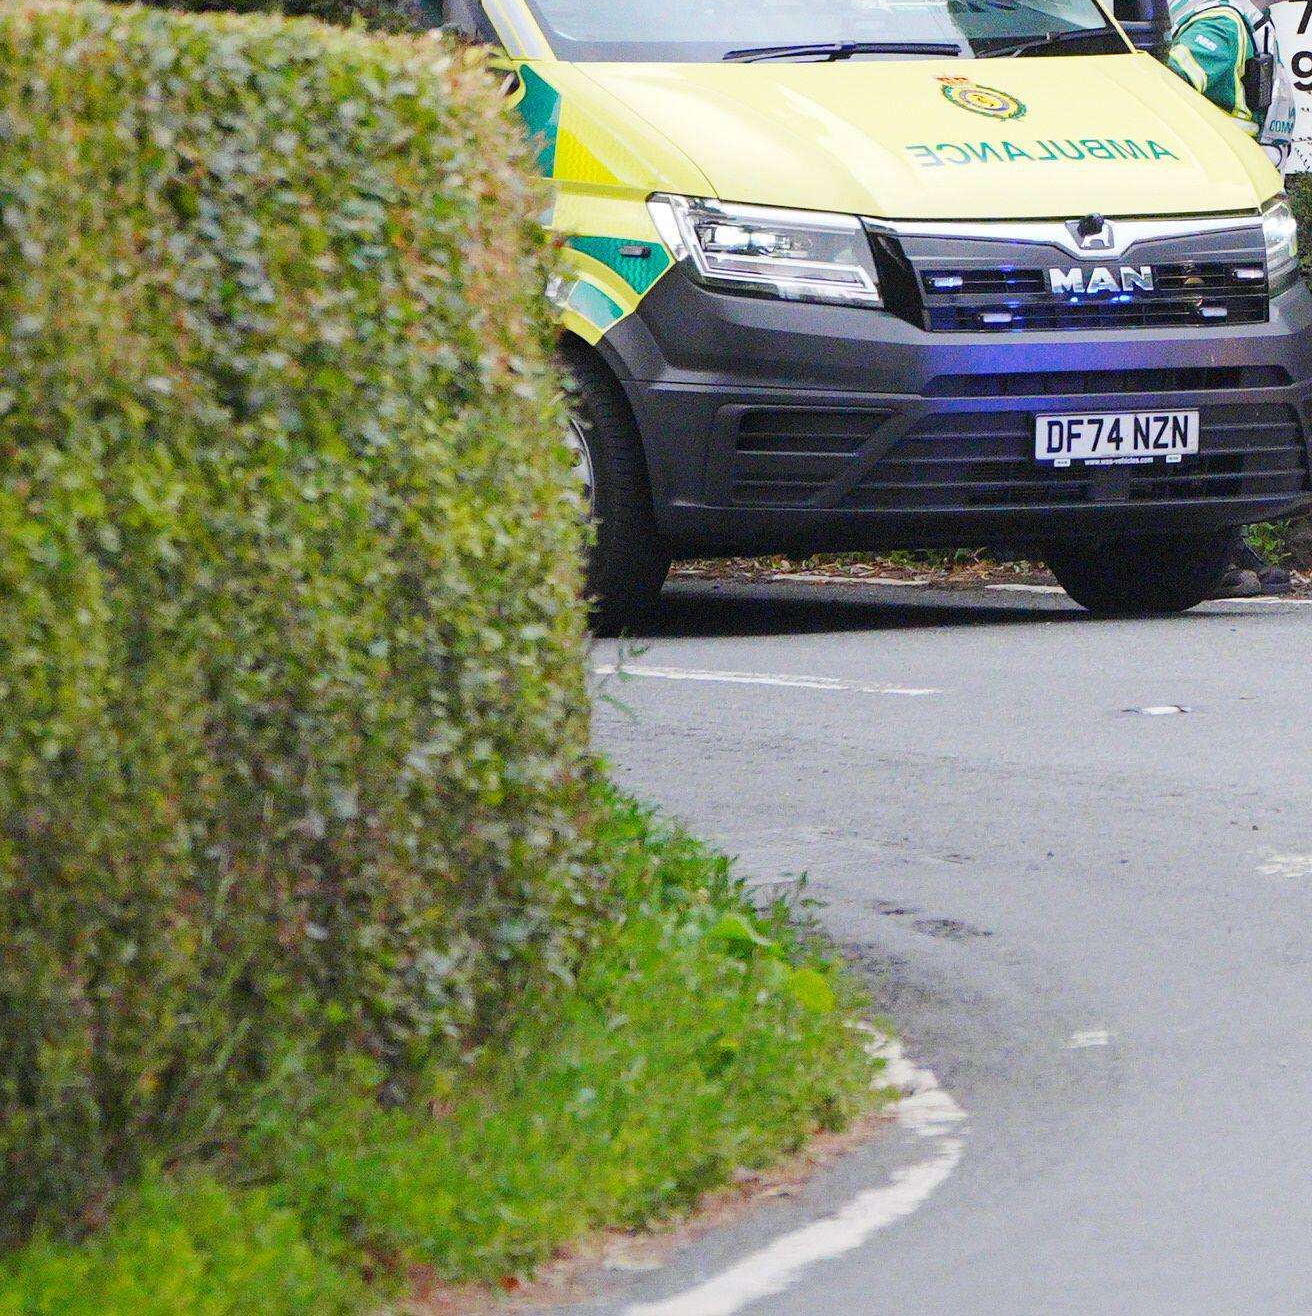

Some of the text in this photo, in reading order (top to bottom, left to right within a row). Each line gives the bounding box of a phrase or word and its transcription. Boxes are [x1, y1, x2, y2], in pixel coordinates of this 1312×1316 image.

[1194, 34, 1218, 52] NHS
[1049, 266, 1154, 294] MAN
[1046, 415, 1189, 454] DF74 NZN
